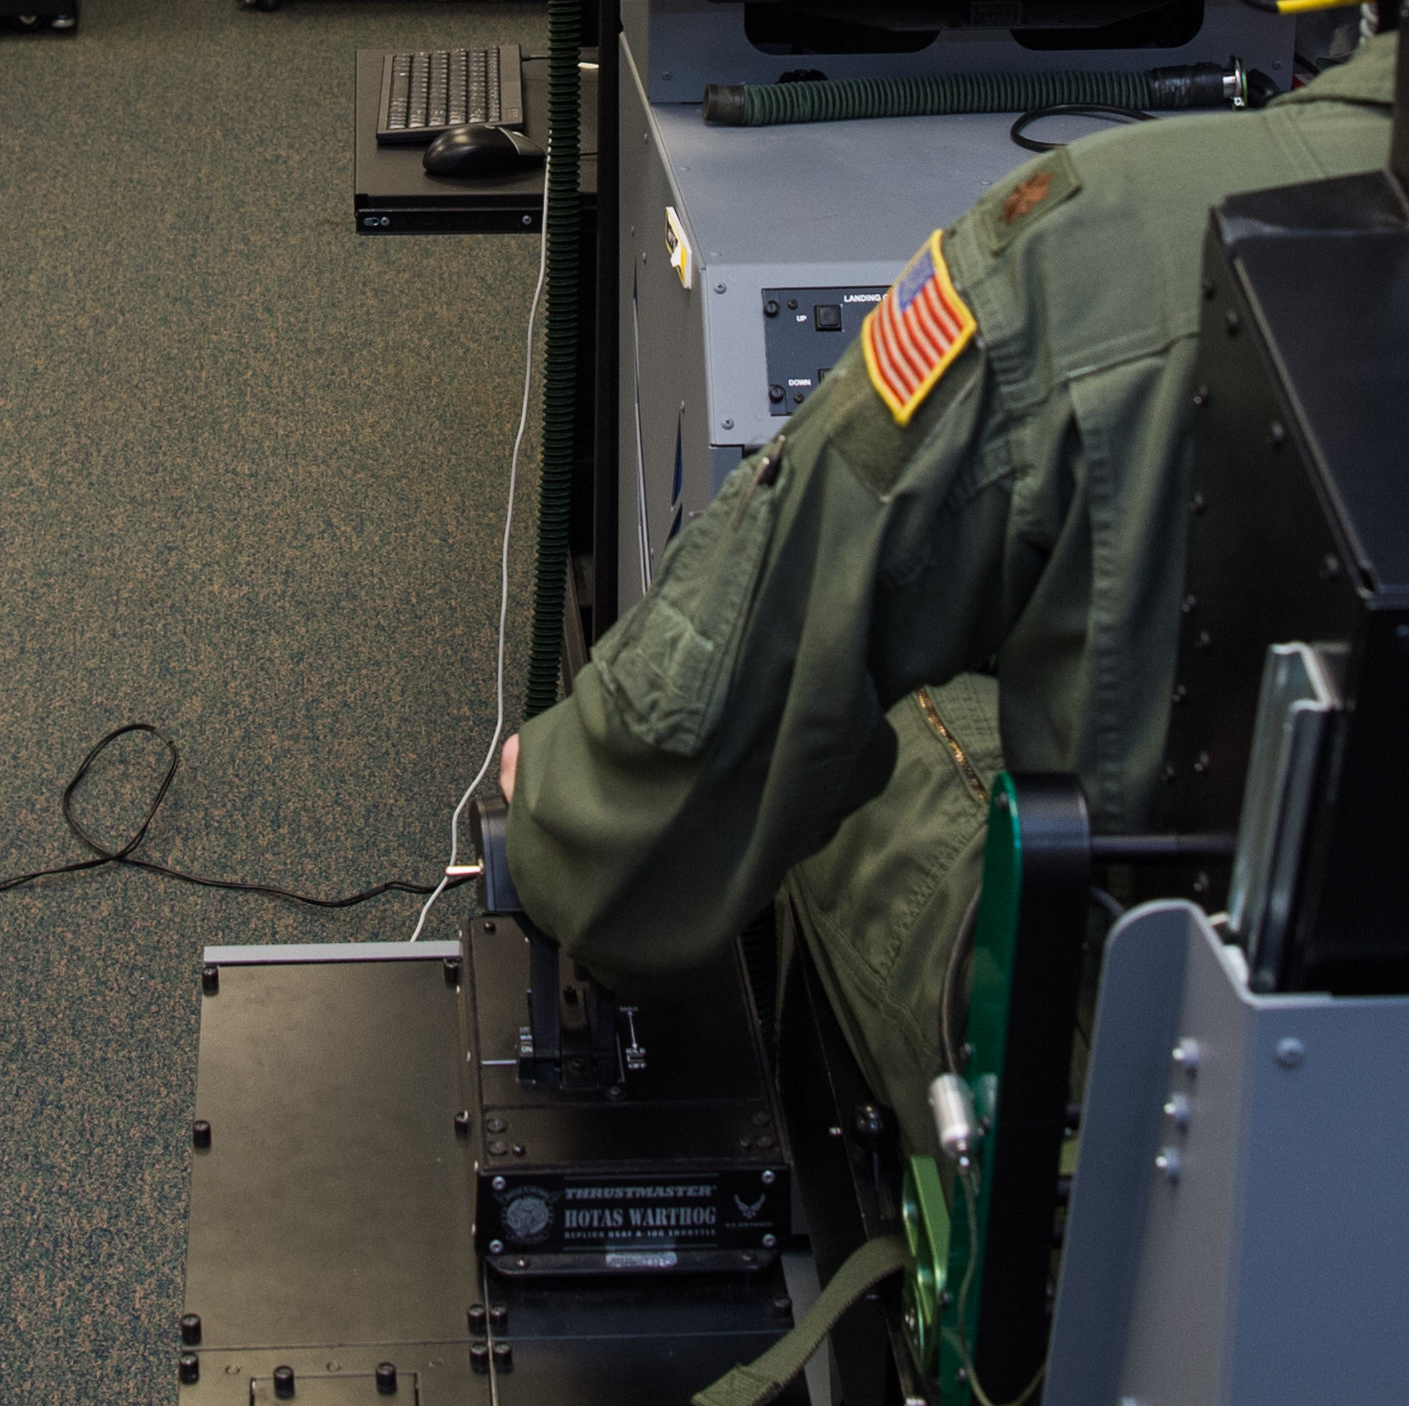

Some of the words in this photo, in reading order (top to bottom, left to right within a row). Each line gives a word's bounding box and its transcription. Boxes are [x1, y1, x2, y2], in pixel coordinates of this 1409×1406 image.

[844, 294, 881, 302] LANDING
[564, 1185, 712, 1199] THRUSTMASTER
[564, 1209, 623, 1228] HOTAS
[629, 1206, 716, 1227] WARTHOG
[565, 1231, 604, 1239] REPLICA
